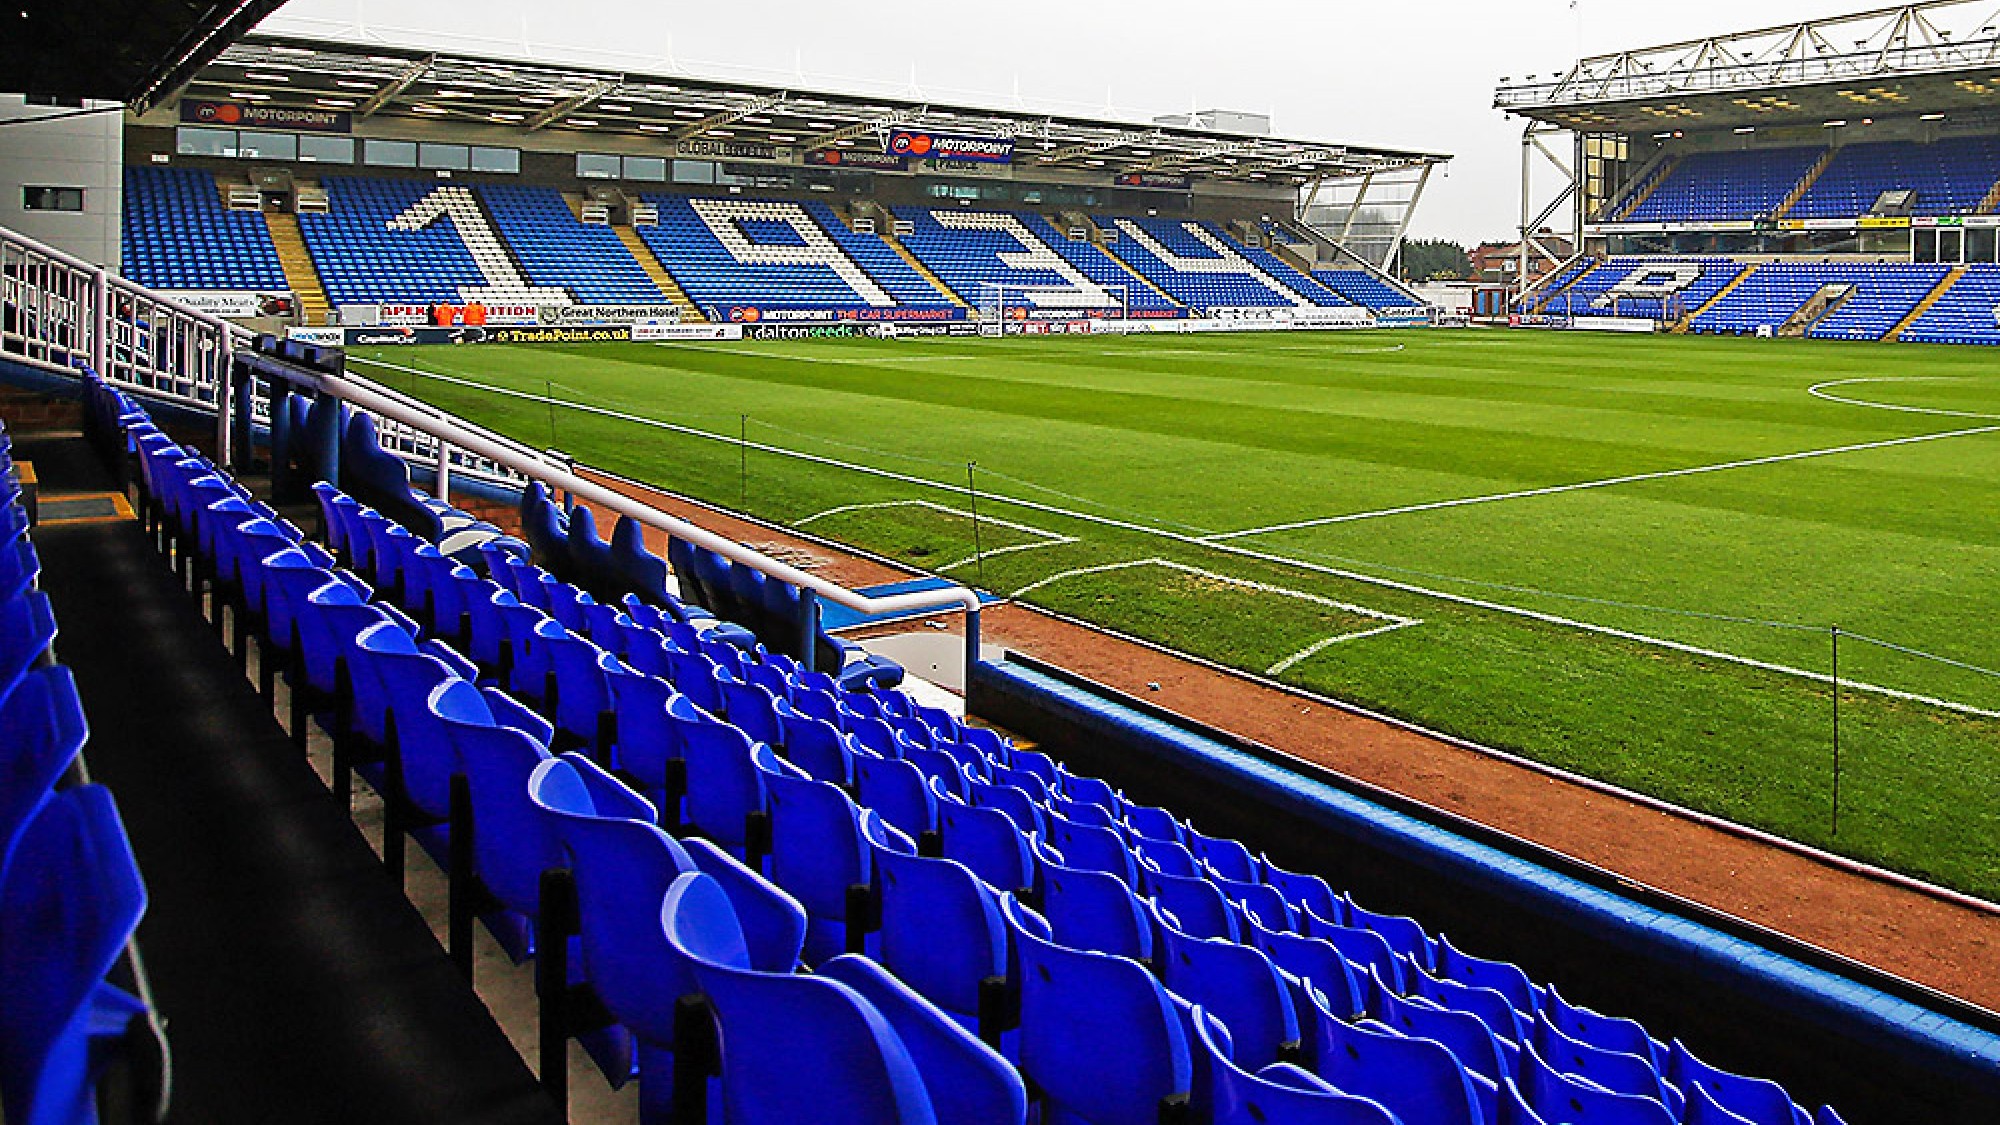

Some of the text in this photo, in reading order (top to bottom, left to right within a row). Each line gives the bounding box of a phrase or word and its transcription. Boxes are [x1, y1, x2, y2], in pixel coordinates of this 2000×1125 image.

[243, 107, 337, 125] MOTORPOINT
[932, 138, 1013, 156] MOTORPOINT
[561, 306, 680, 317] Great Northern Hotel
[761, 309, 953, 320] MOTORPOINT THE CAR SUPERMARKET
[513, 329, 630, 342] TradePoint.co.uk
